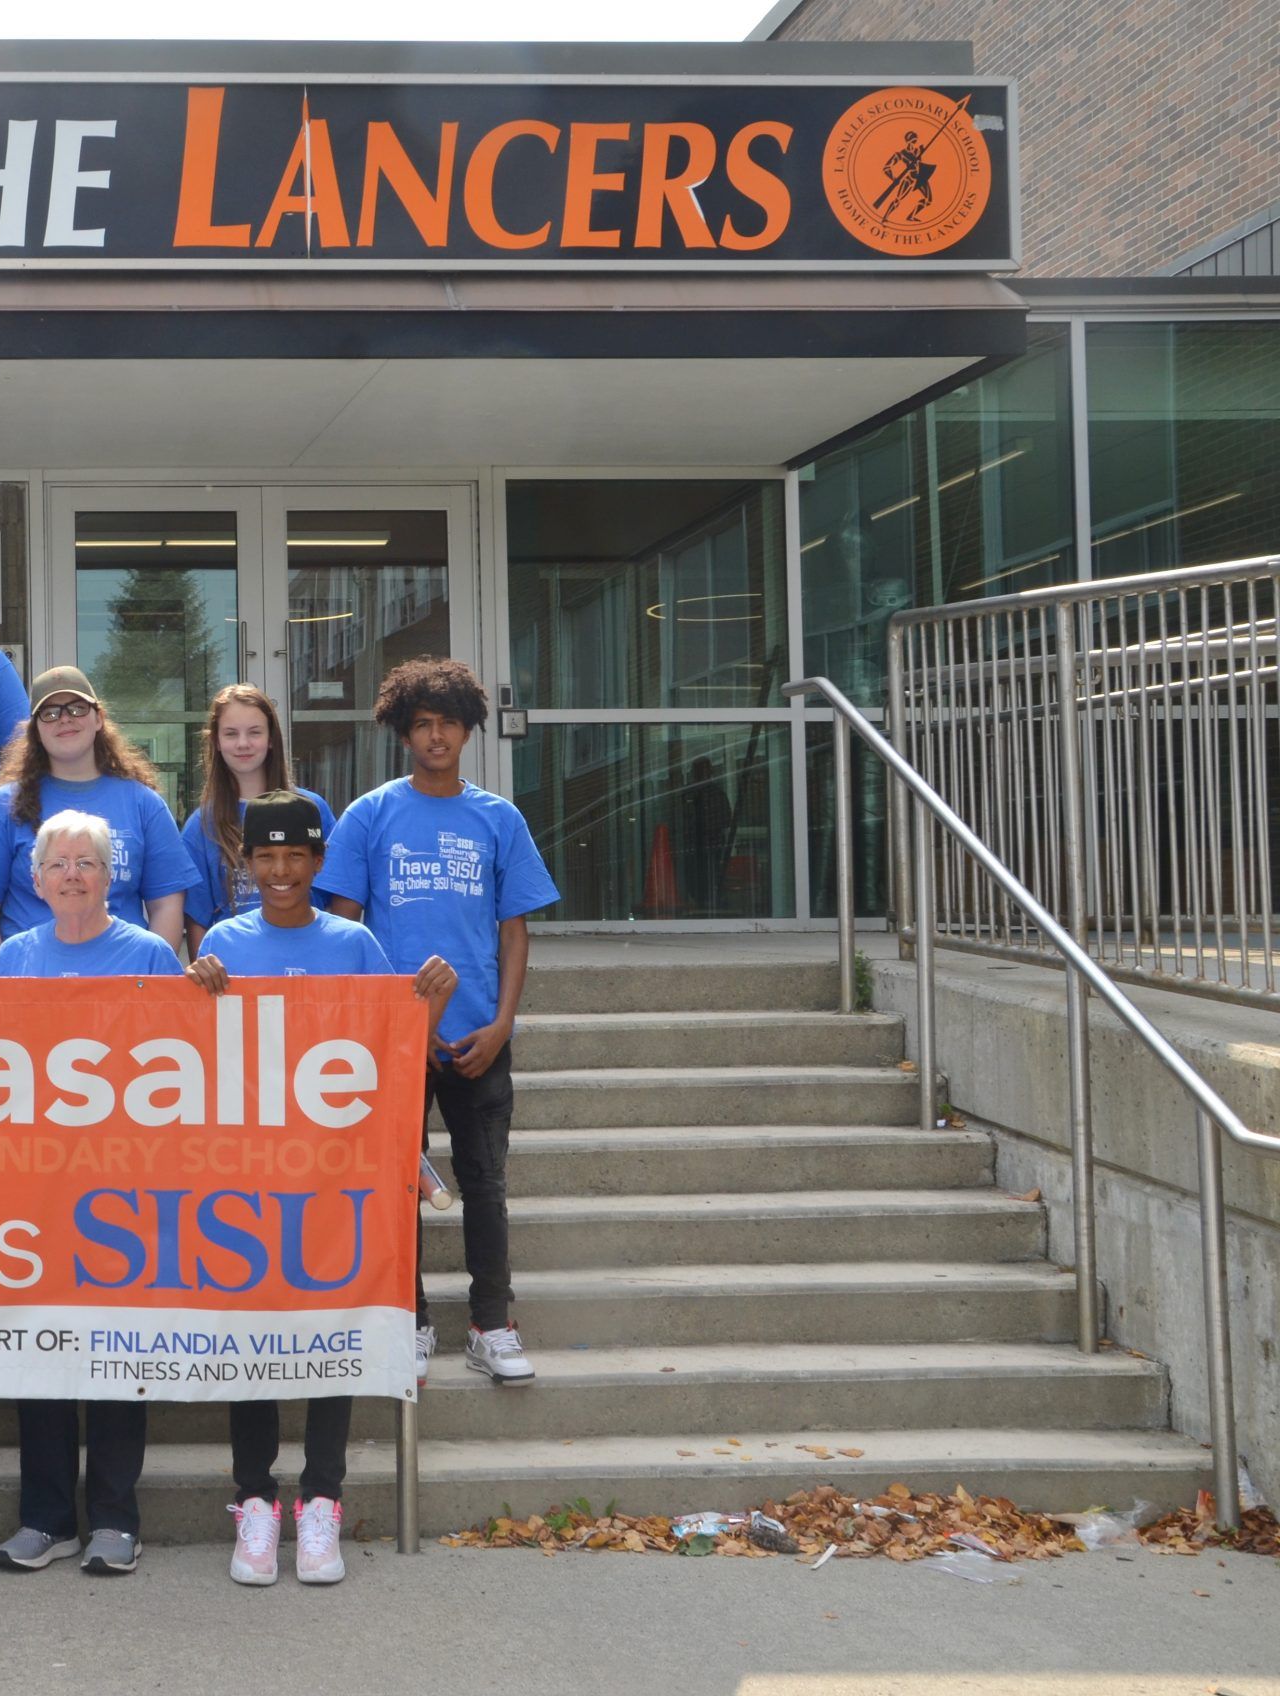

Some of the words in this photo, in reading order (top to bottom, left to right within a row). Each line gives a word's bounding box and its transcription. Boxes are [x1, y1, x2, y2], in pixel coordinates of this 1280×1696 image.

[833, 113, 869, 174] LASALLE
[866, 98, 951, 121] SECONDARY
[951, 121, 981, 176] SCHOOL
[172, 86, 794, 251] LANCERS
[837, 188, 870, 230] HOME
[870, 227, 890, 241] OF
[893, 233, 924, 245] THE
[925, 191, 978, 243] LANCERS
[456, 837, 474, 850] SISU
[389, 859, 393, 876] I
[400, 858, 441, 876] have
[447, 859, 482, 880] SISU
[433, 877, 449, 891] SISU
[450, 878, 468, 897] Family
[180, 1137, 379, 1178] SCHOOL
[73, 1187, 376, 1293] SISU
[35, 1329, 81, 1353] OF:
[89, 1330, 241, 1356] FINLANDIA
[248, 1329, 363, 1355] VILLAGE
[89, 1359, 181, 1381] FITNESS
[185, 1361, 239, 1382] AND
[243, 1357, 363, 1381] WELLNESS
